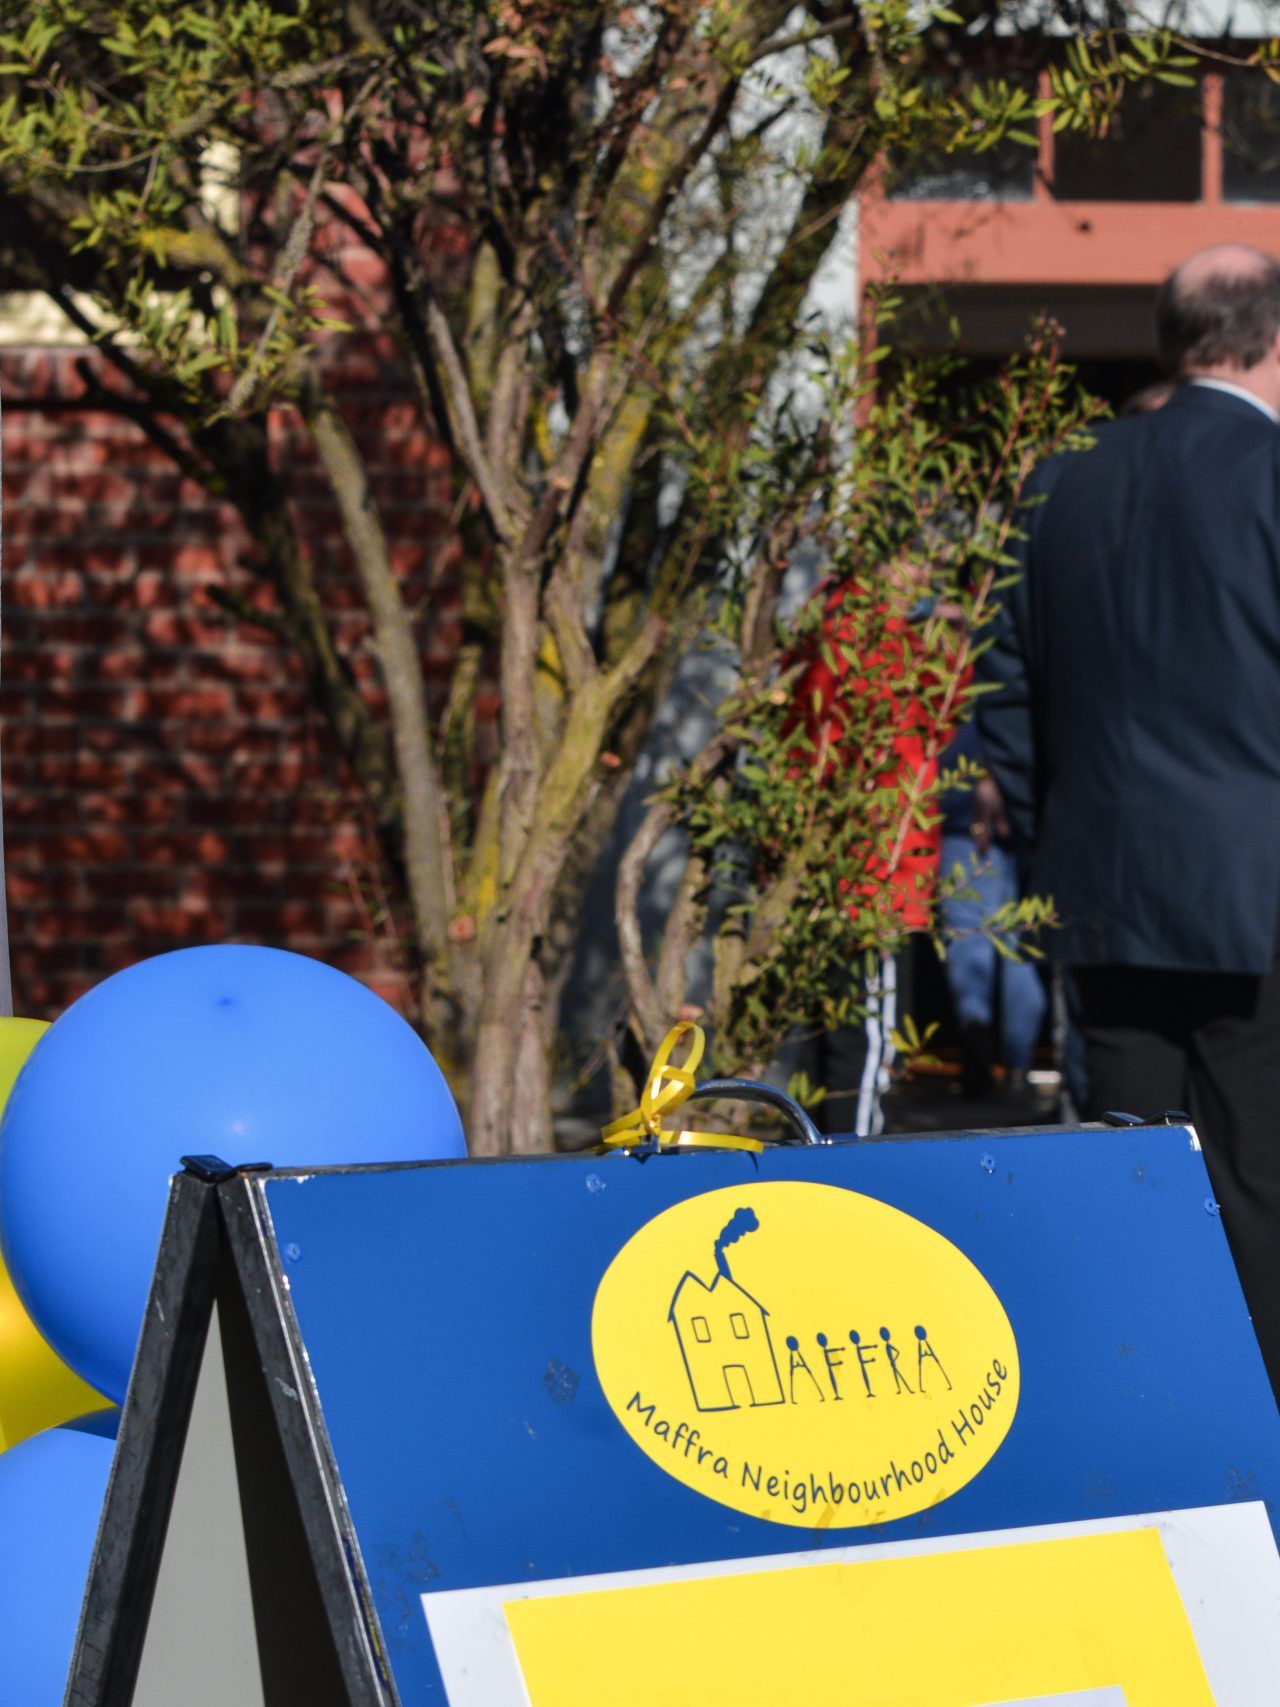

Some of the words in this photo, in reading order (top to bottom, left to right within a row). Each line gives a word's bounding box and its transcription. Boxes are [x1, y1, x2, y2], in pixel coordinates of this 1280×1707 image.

[626, 1392, 729, 1480] Maffra
[741, 1429, 954, 1513] Neighbourhood
[951, 1358, 1008, 1446] House
